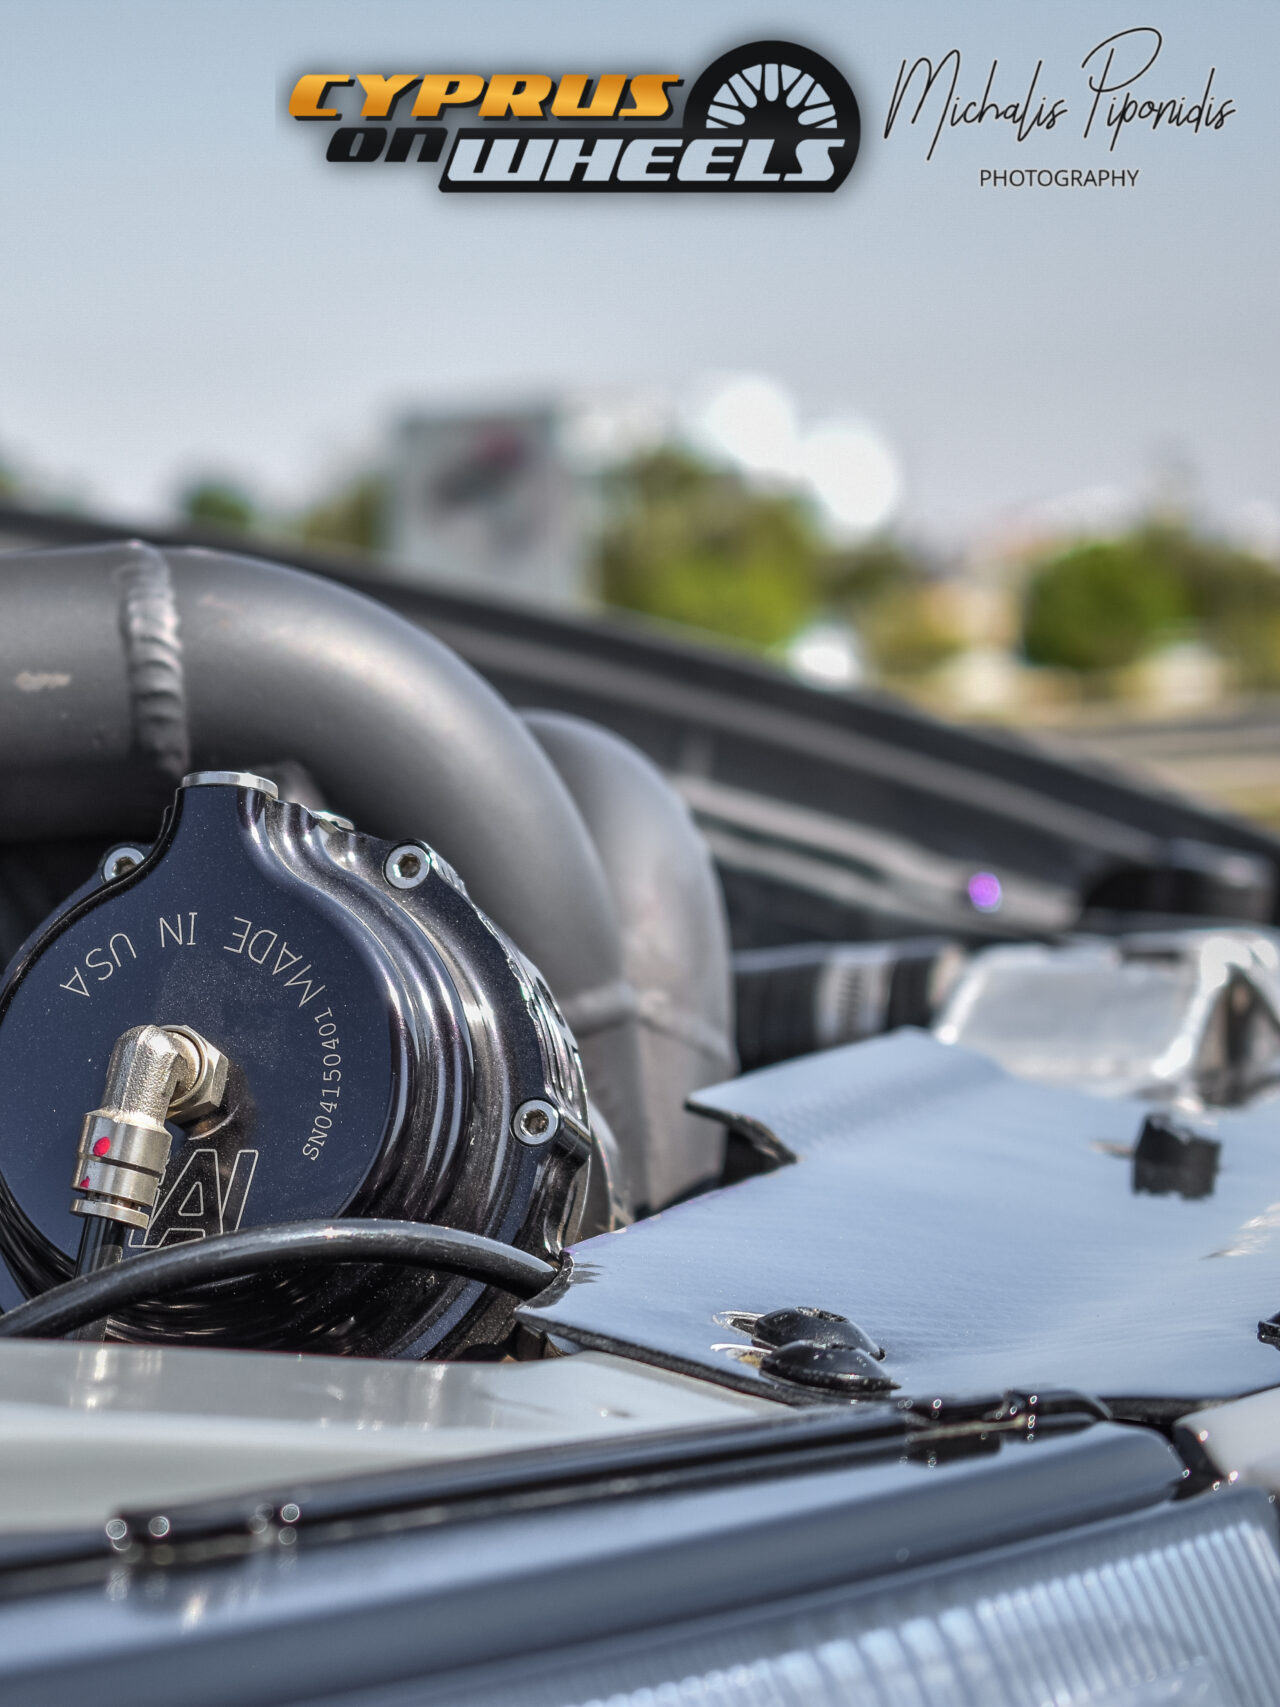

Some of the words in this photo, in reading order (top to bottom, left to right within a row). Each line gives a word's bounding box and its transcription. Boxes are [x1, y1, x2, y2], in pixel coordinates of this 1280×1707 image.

[159, 911, 198, 948] IN
[223, 915, 326, 1008] MADE
[58, 932, 138, 998] USA
